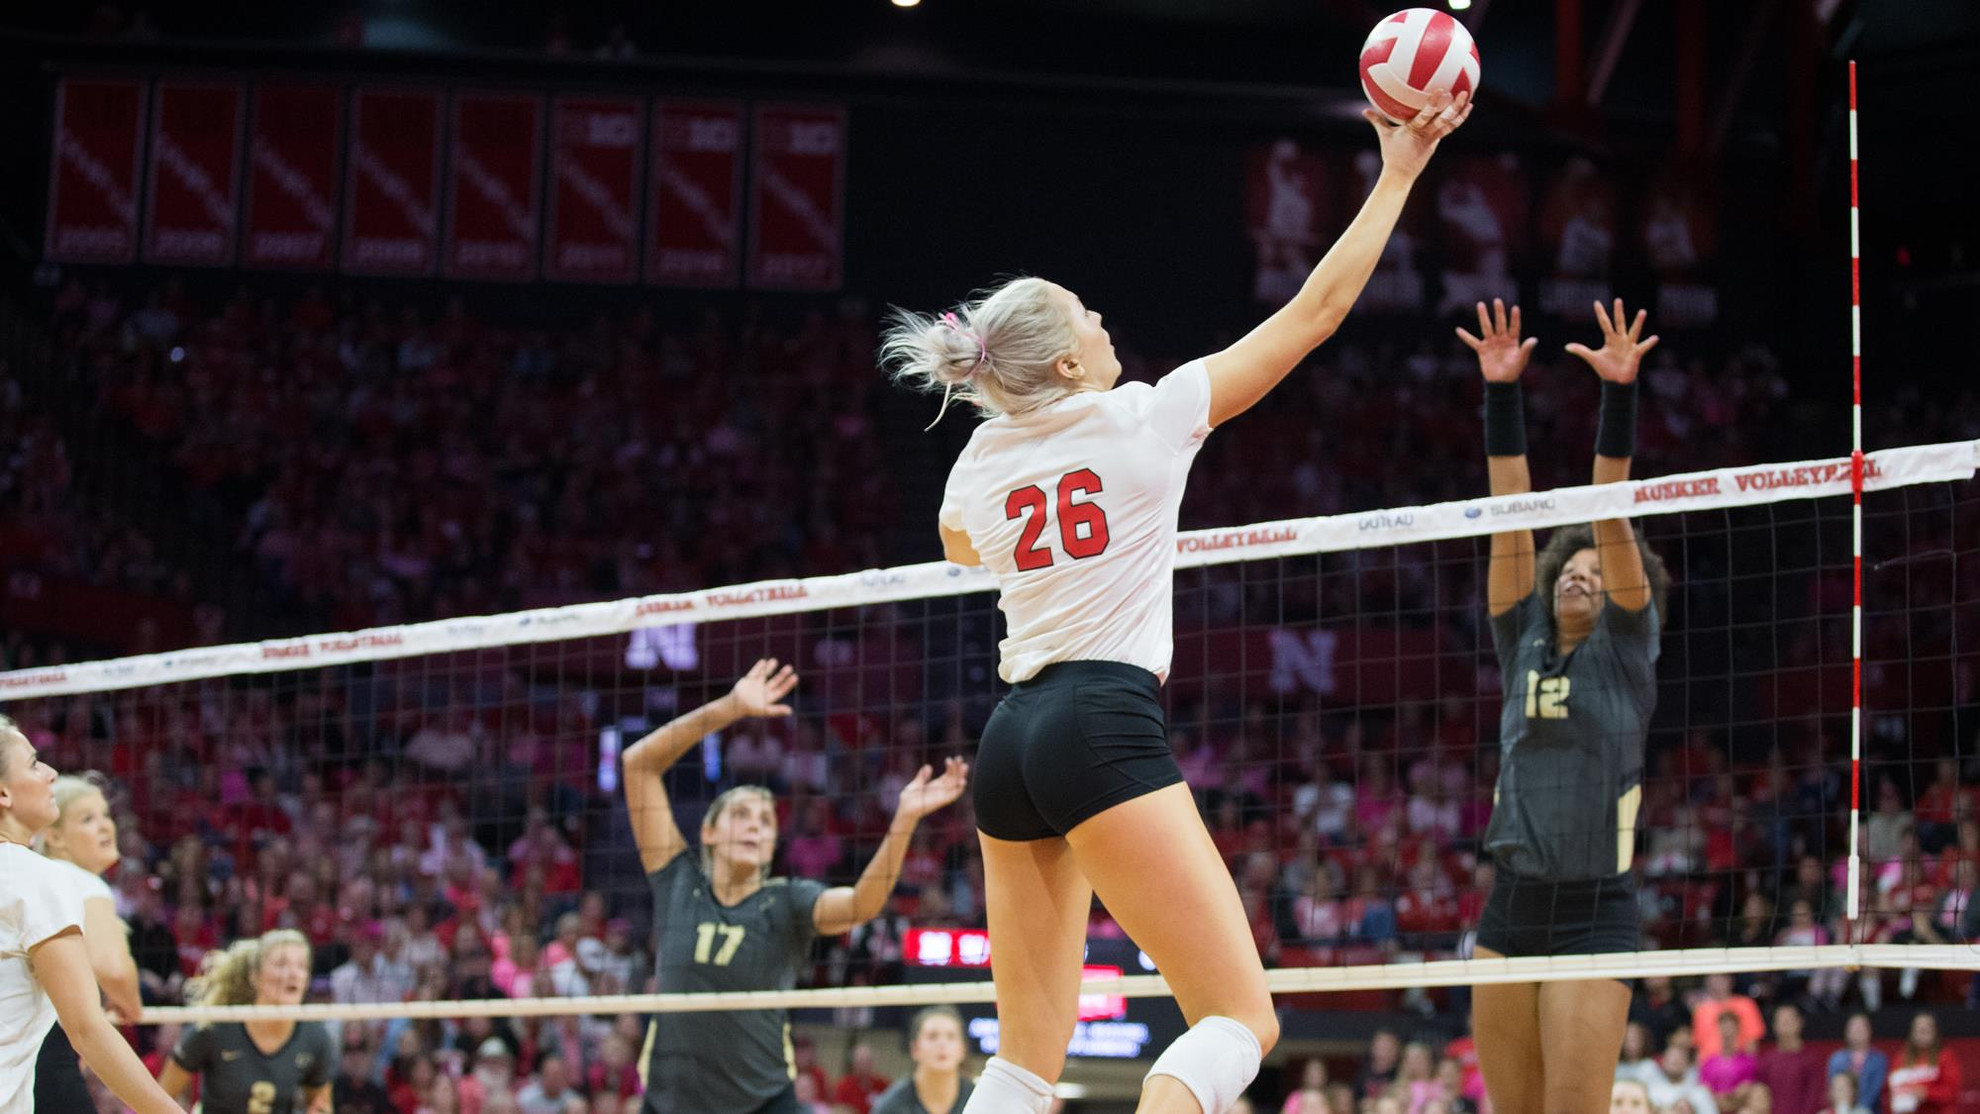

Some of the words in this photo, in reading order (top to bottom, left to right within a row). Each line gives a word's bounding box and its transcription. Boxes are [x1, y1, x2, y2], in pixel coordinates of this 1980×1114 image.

[1634, 477, 1721, 503] HUSKER
[1735, 459, 1881, 493] VOLLEYBAL
[1005, 467, 1110, 572] 26
[1358, 513, 1414, 531] DUTEAU
[1490, 498, 1556, 516] SUBARU
[1176, 527, 1297, 553] VOLLEYBALL
[625, 622, 699, 671] N
[1268, 629, 1337, 694] N
[1525, 669, 1571, 719] 12
[694, 922, 745, 966] 17
[247, 1080, 277, 1114] 2
